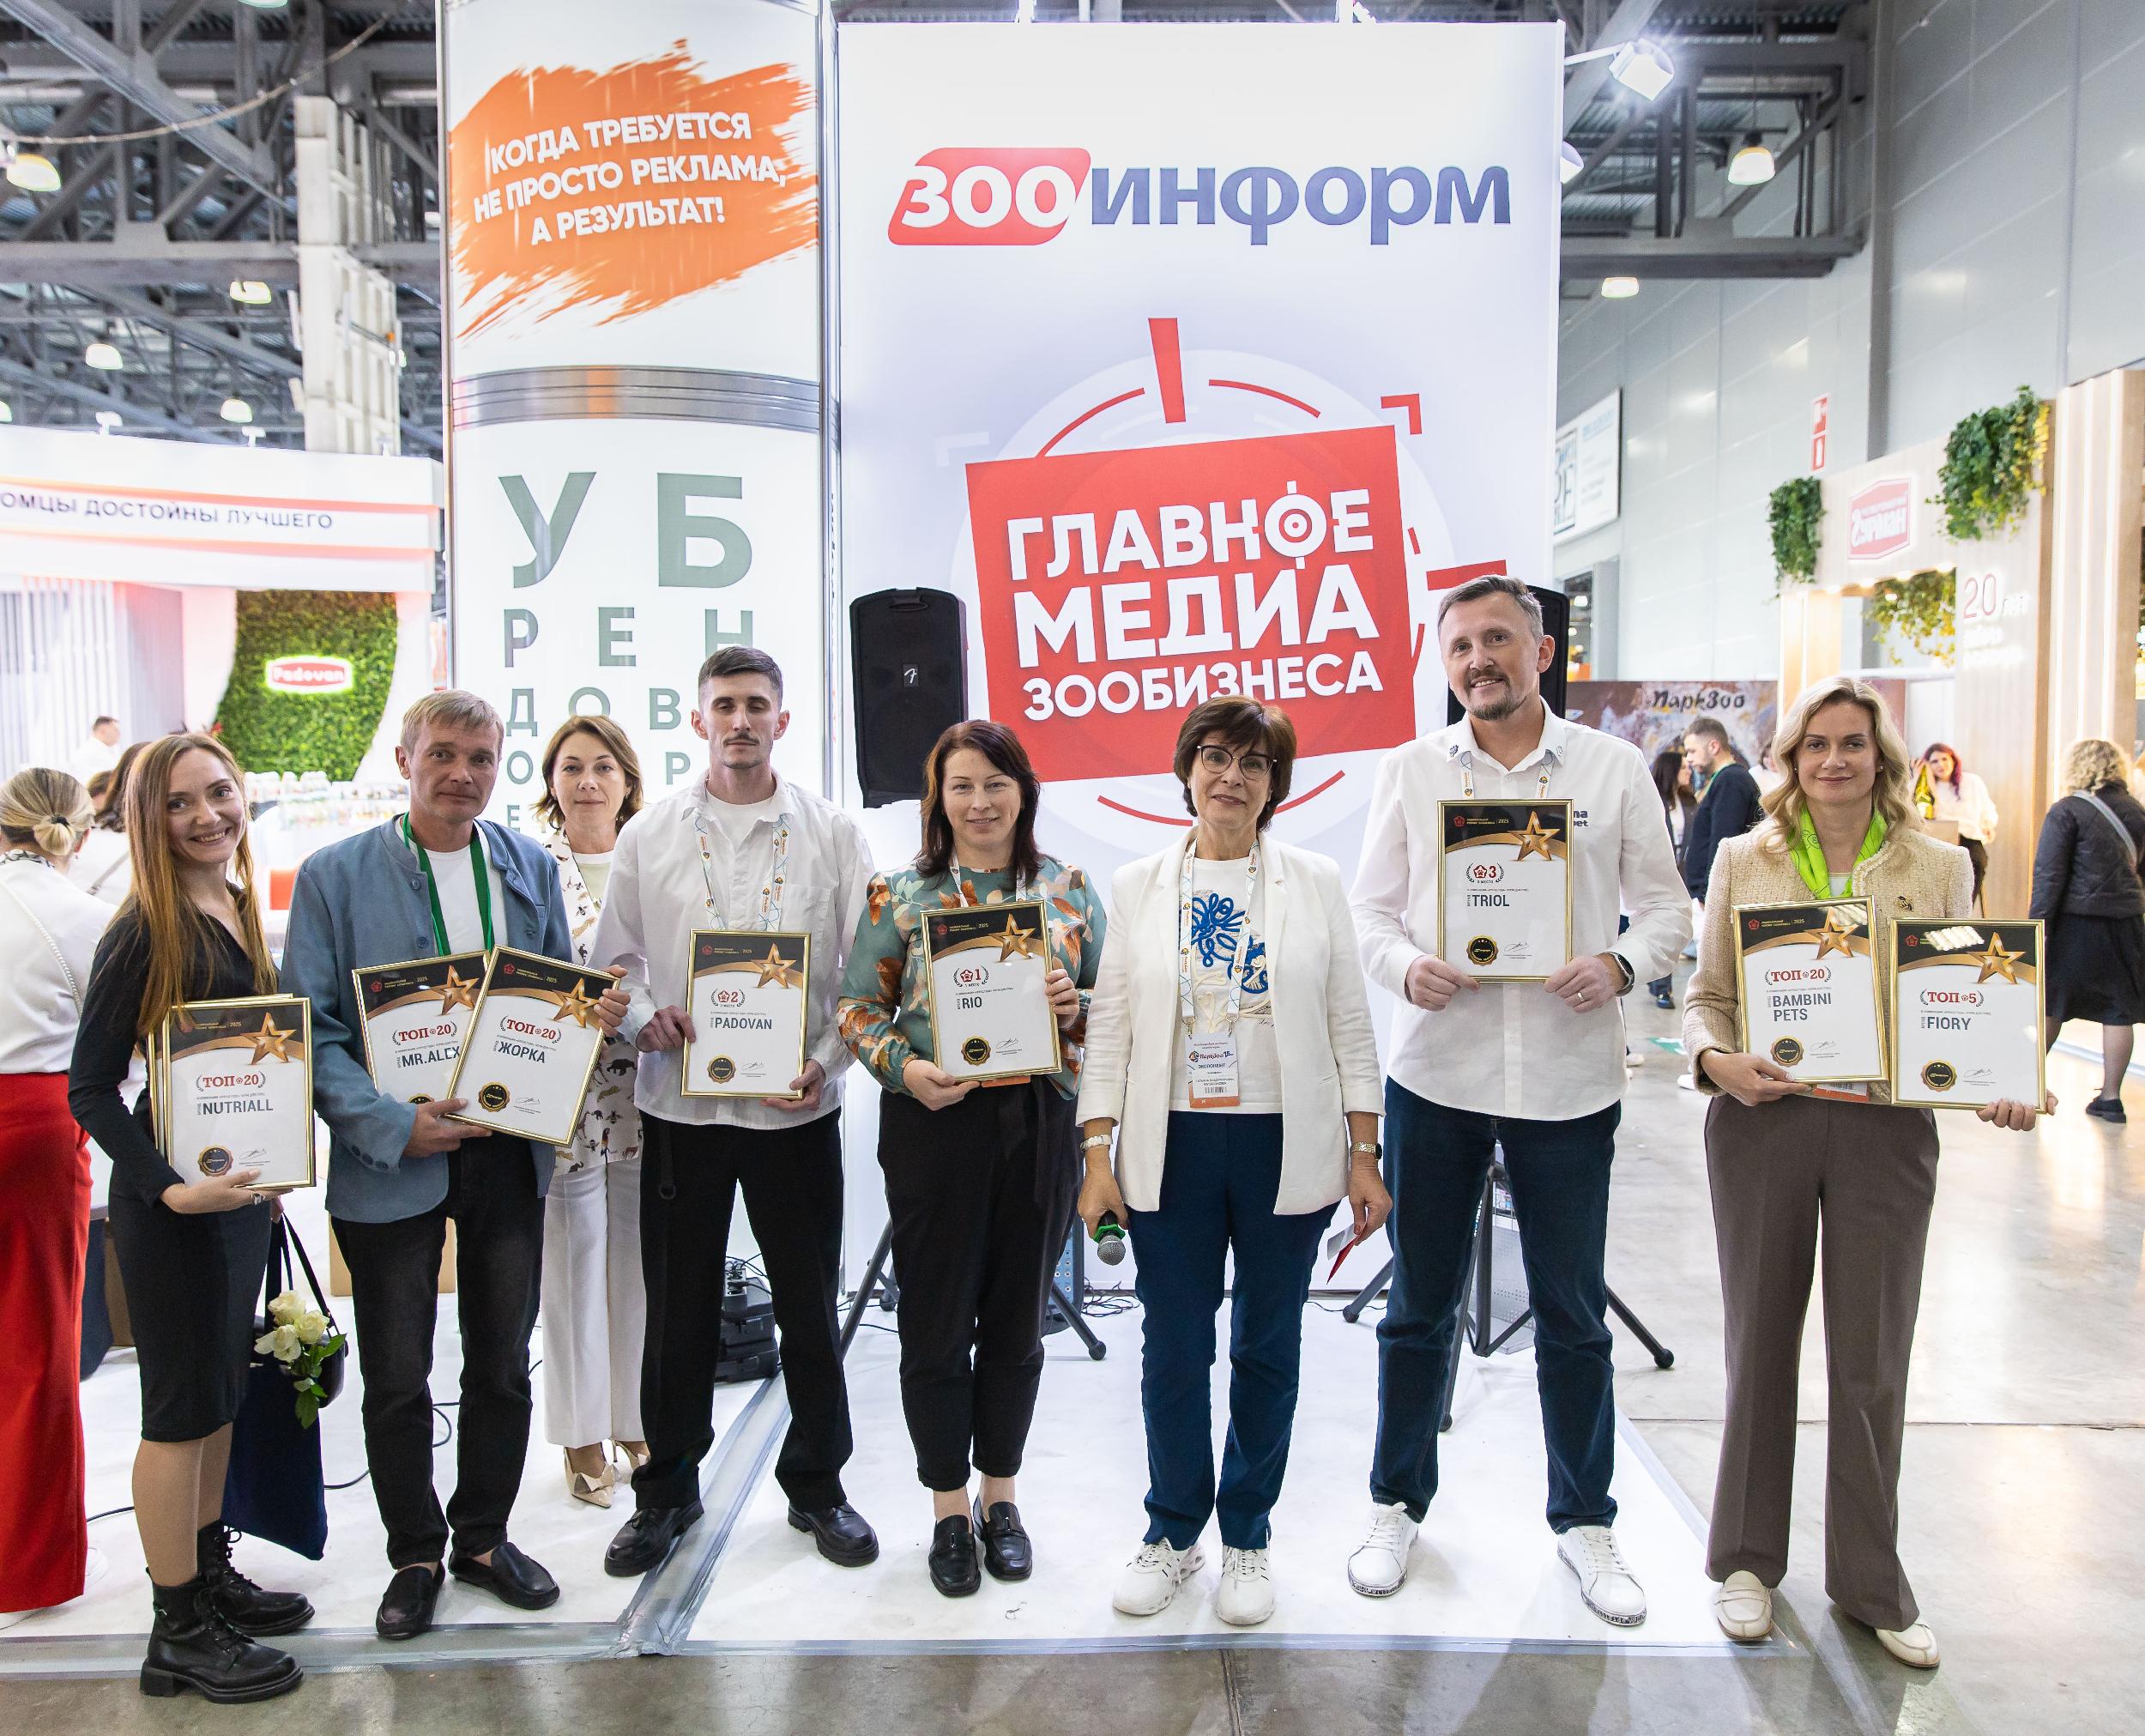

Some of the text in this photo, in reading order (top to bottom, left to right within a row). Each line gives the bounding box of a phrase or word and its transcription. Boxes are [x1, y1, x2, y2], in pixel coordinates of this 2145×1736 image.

[490, 112, 752, 174] КОГДА ТРЕБУЕТСЯ
[474, 154, 787, 223] НЕ ПРОСТО РЕКЛАМА,
[530, 197, 726, 245] А РЕЗУЛЬТАТ!
[85, 499, 218, 523] ДОСТОЙНЫ
[227, 509, 332, 529] ЛУЧШЕГО
[498, 472, 596, 588] У
[657, 472, 752, 588] Б
[1007, 484, 1374, 581] ГЛАВНОЕ
[1963, 573, 1996, 619] 20
[1013, 564, 1380, 668] МЕДИА
[1024, 650, 1383, 722] ЗООБИЗНЕСА
[1489, 865, 1497, 879] 3
[1472, 894, 1510, 907] TRIOL
[1771, 968, 1825, 982] ТОП 20
[731, 991, 739, 1003] 2
[962, 996, 982, 1009] RIO
[1773, 993, 1832, 1007] BAMBINI
[1927, 991, 1977, 1004] ТОП 5
[715, 1017, 772, 1030] PADOVAN
[1773, 1009, 1808, 1022] PETS
[1927, 1016, 1972, 1031] FIORY
[398, 1024, 451, 1042] ТОП 20
[506, 1019, 556, 1040] ТОП 20
[402, 1045, 460, 1068] MR.ALEX
[498, 1041, 546, 1063] ЖОРКА
[202, 1074, 259, 1088] ТОП 20
[202, 1099, 274, 1116] NUTRIALL
